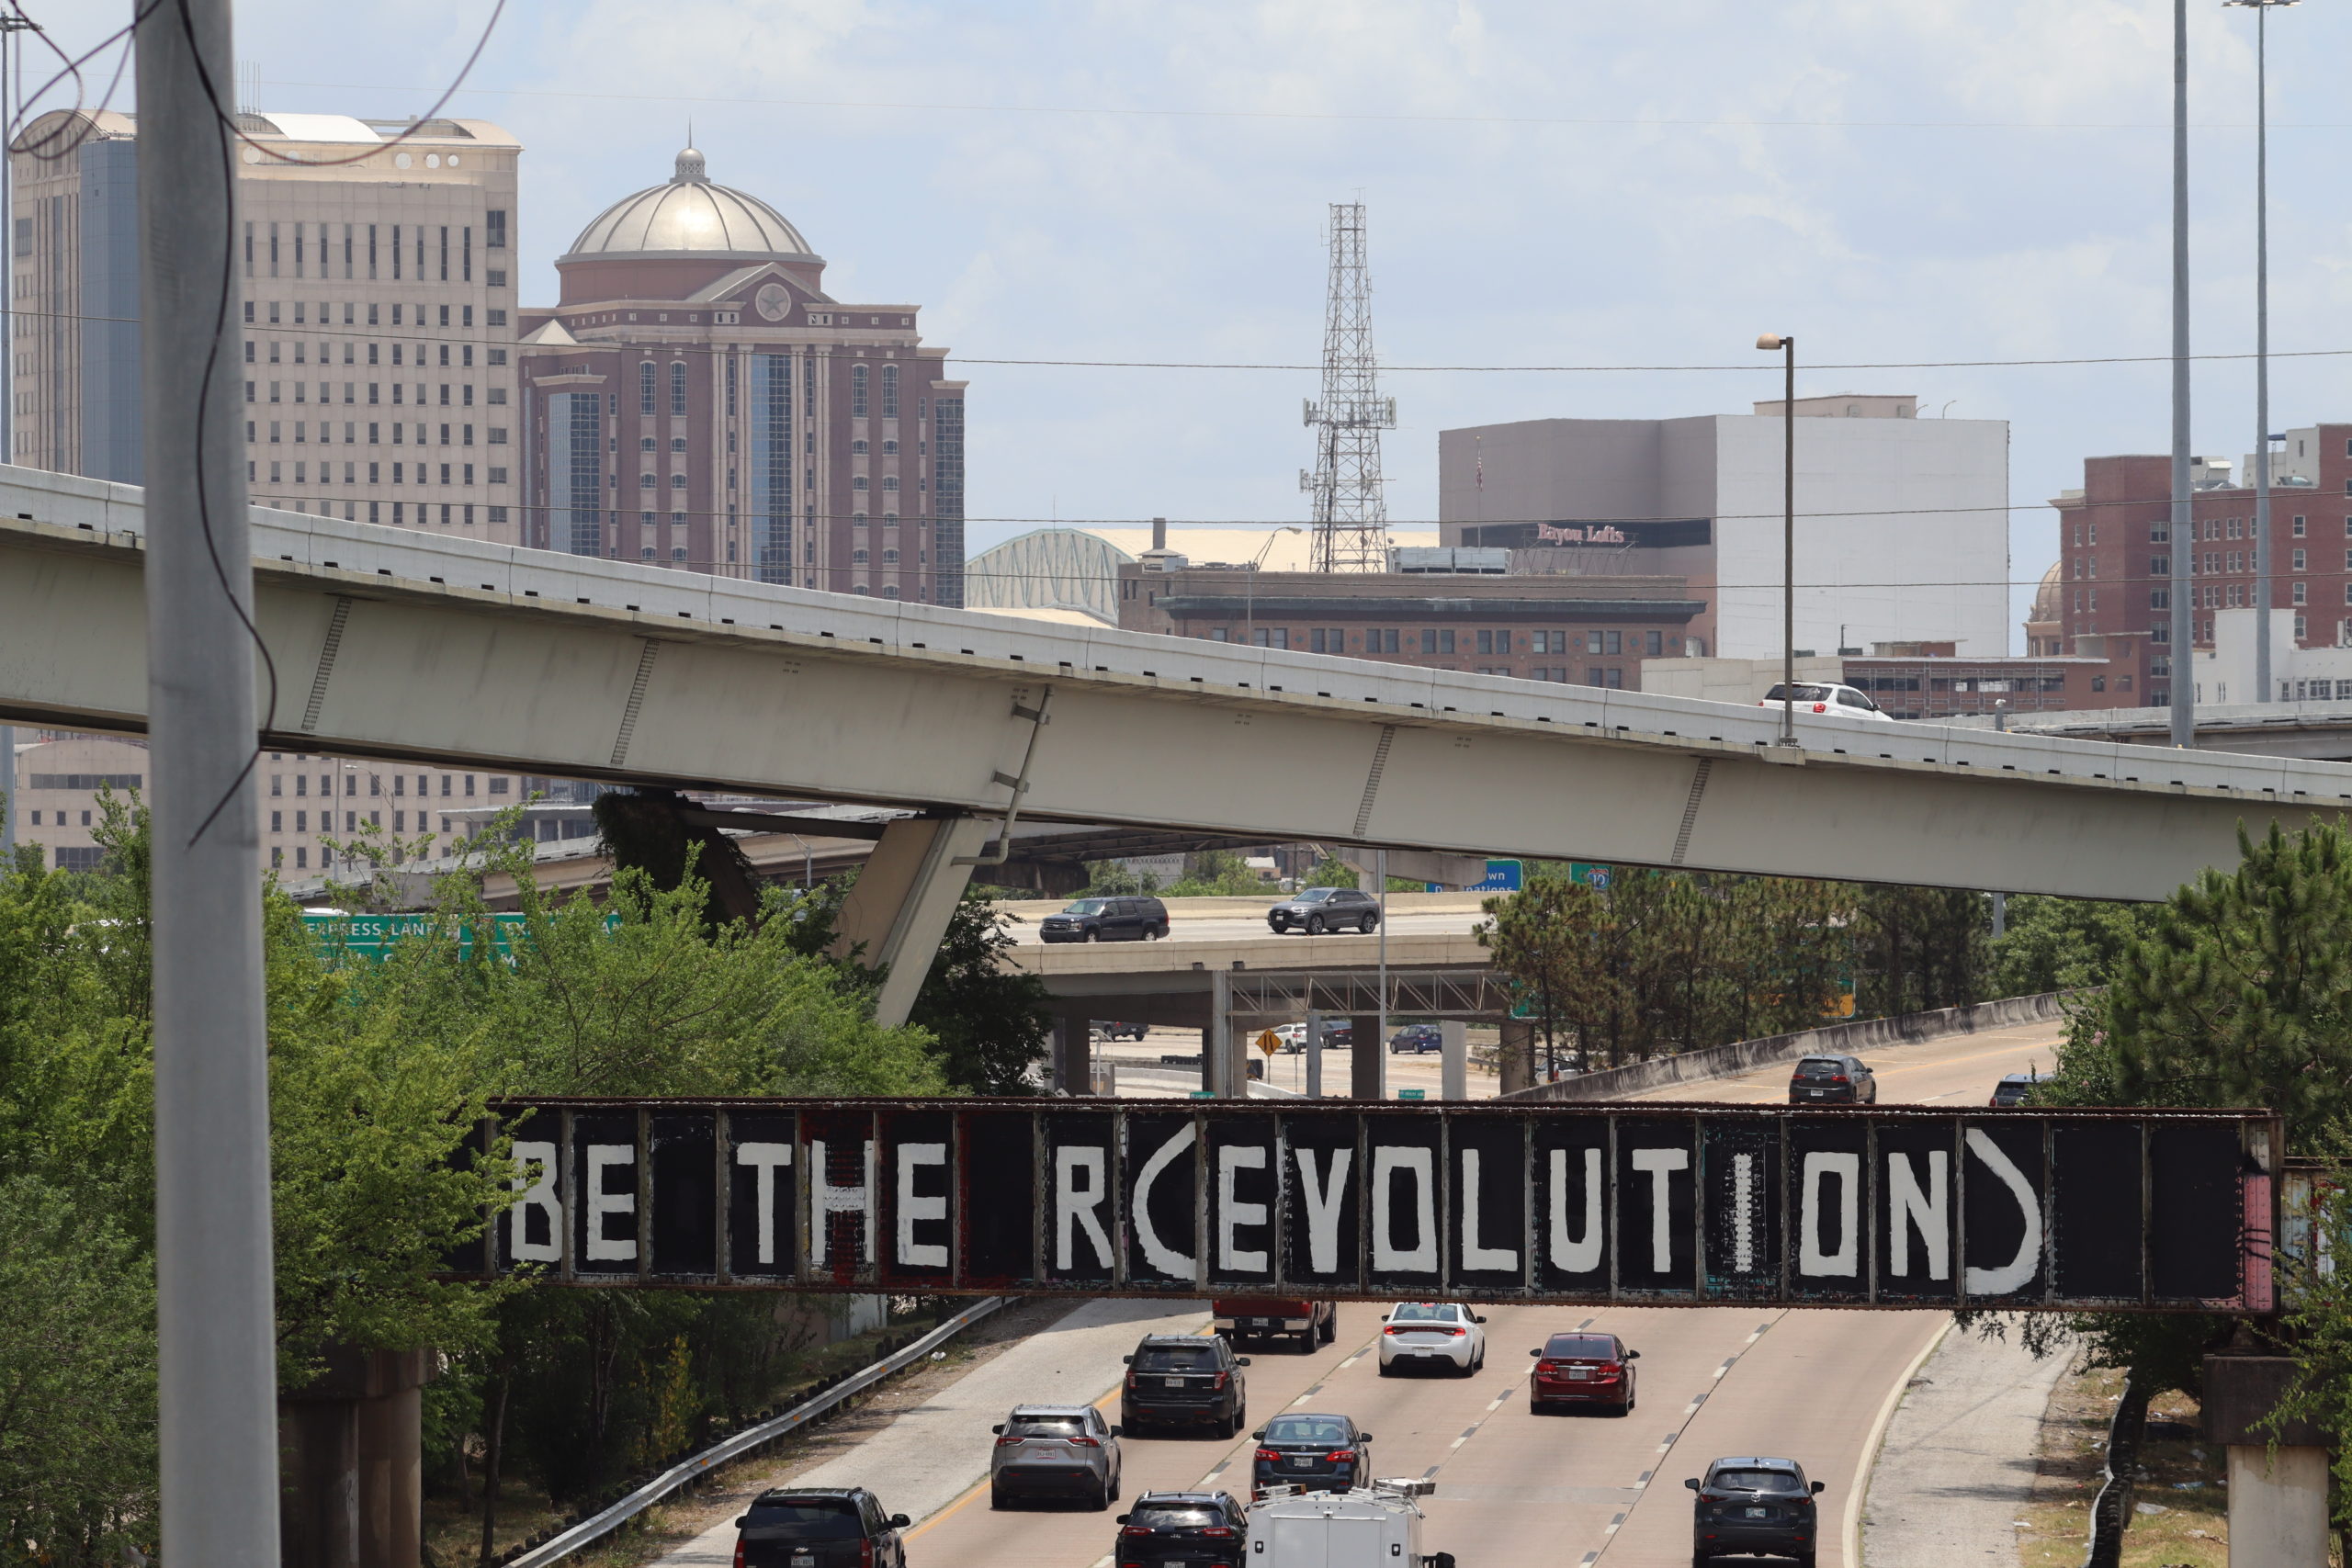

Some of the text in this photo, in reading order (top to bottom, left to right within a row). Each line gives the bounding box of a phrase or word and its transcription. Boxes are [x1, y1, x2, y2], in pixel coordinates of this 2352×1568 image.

[1537, 523, 1624, 546] Bayou Lofts
[1593, 874, 1606, 886] 10
[511, 1141, 638, 1263] BE
[736, 1138, 949, 1269] THE
